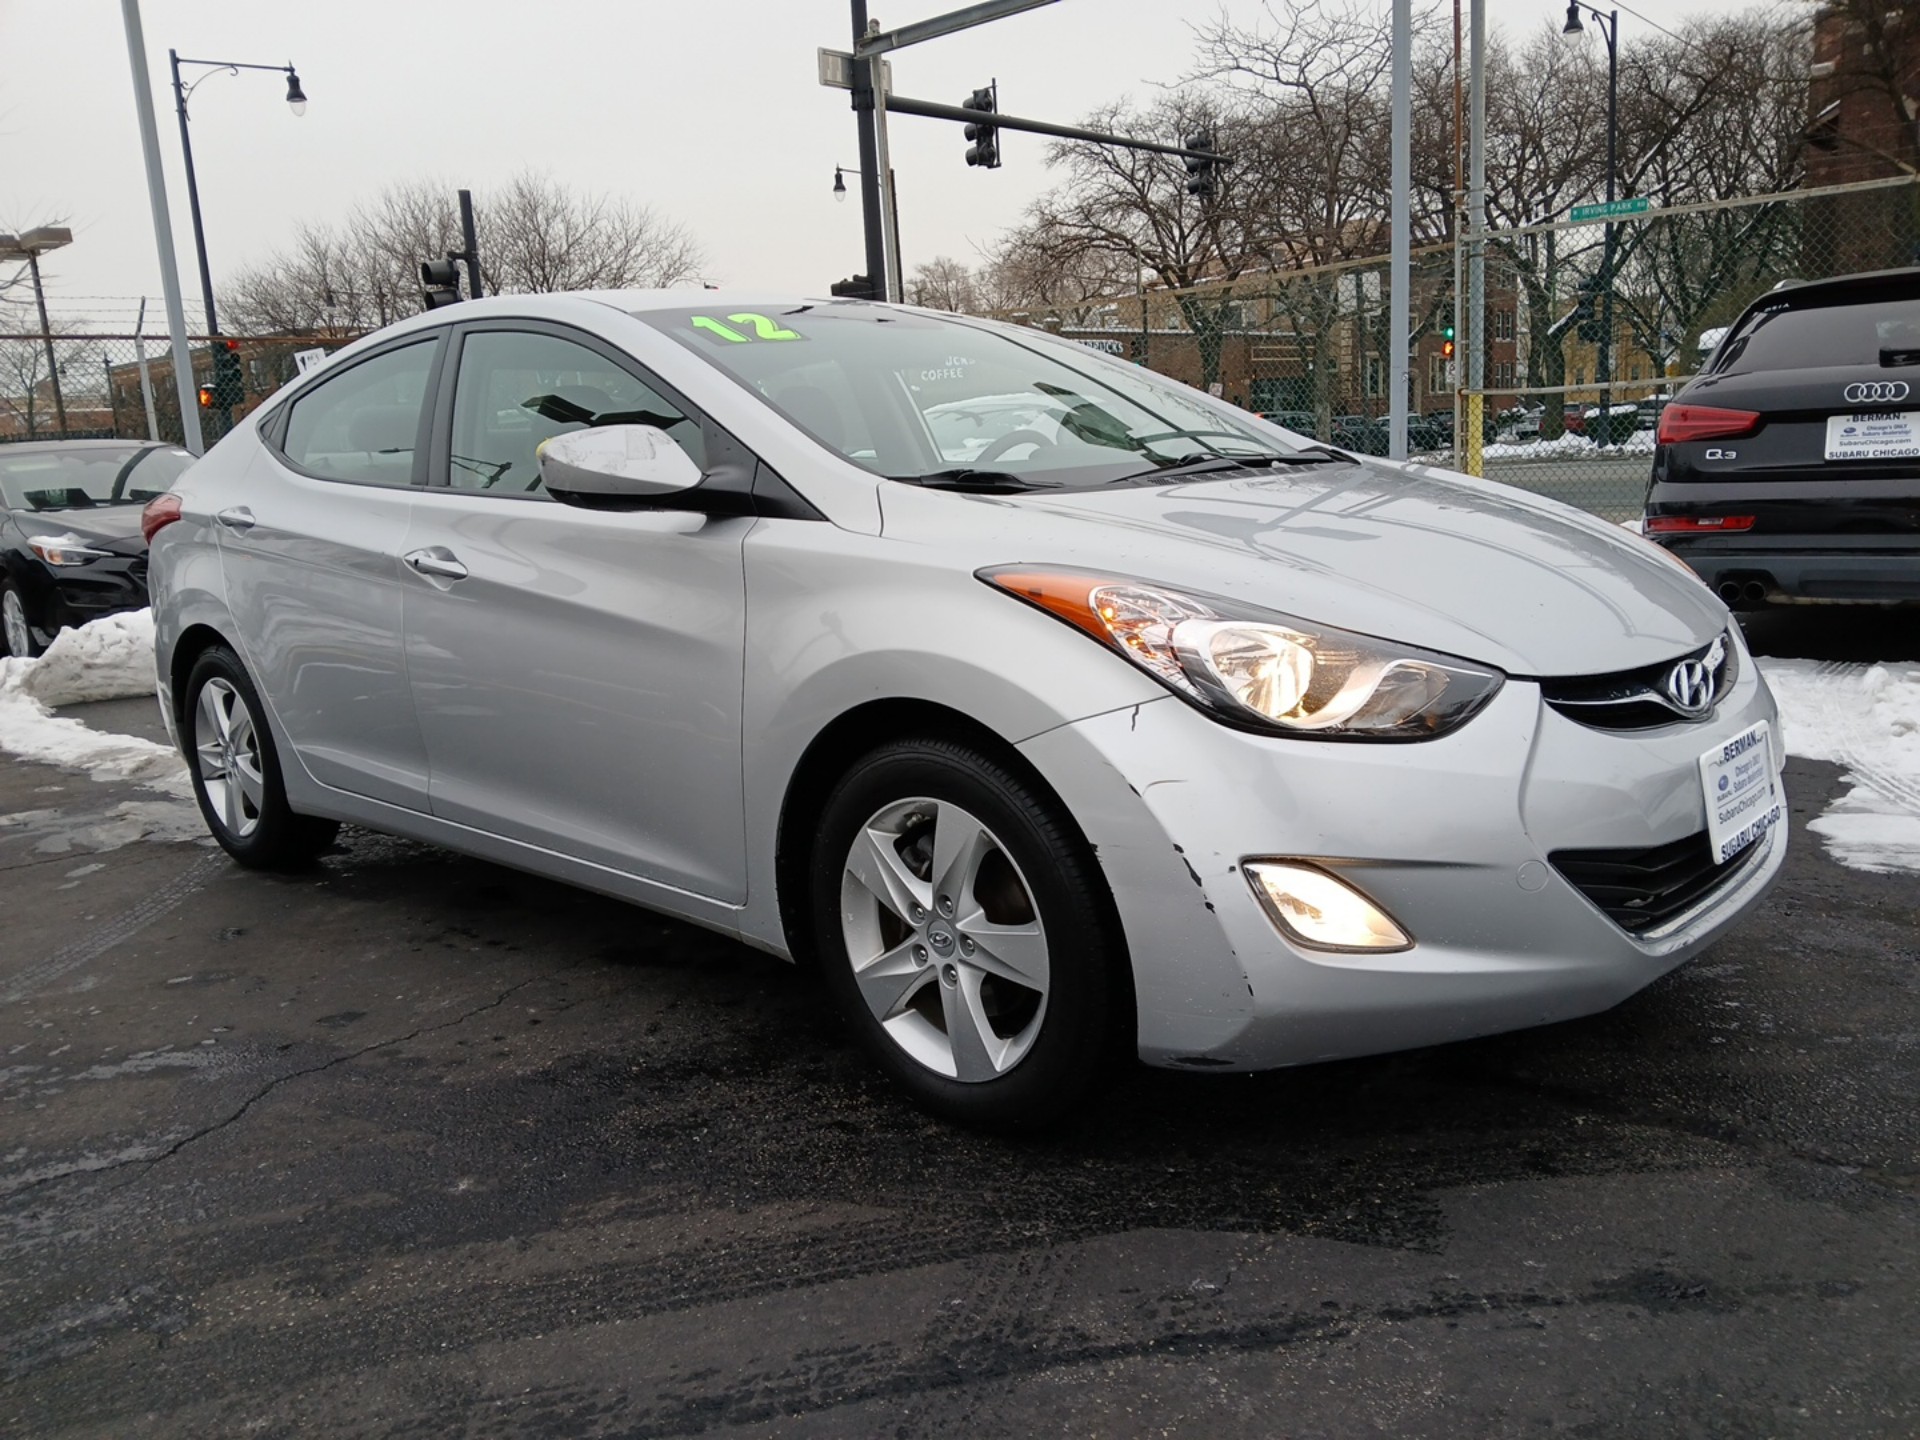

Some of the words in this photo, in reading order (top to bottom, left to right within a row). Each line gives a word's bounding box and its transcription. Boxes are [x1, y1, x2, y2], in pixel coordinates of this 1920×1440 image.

[1610, 202, 1632, 212] PARK
[690, 313, 801, 342] 12
[921, 367, 964, 381] COFFEE
[1852, 412, 1901, 423] BERMAN
[1839, 439, 1912, 447] SubaruChicago.com
[1705, 449, 1737, 460] Q3
[1829, 450, 1870, 459] SUBARU
[1872, 448, 1920, 457] CHICAGO
[1723, 729, 1758, 763] BERMAN
[1751, 804, 1781, 838] CHICAGO
